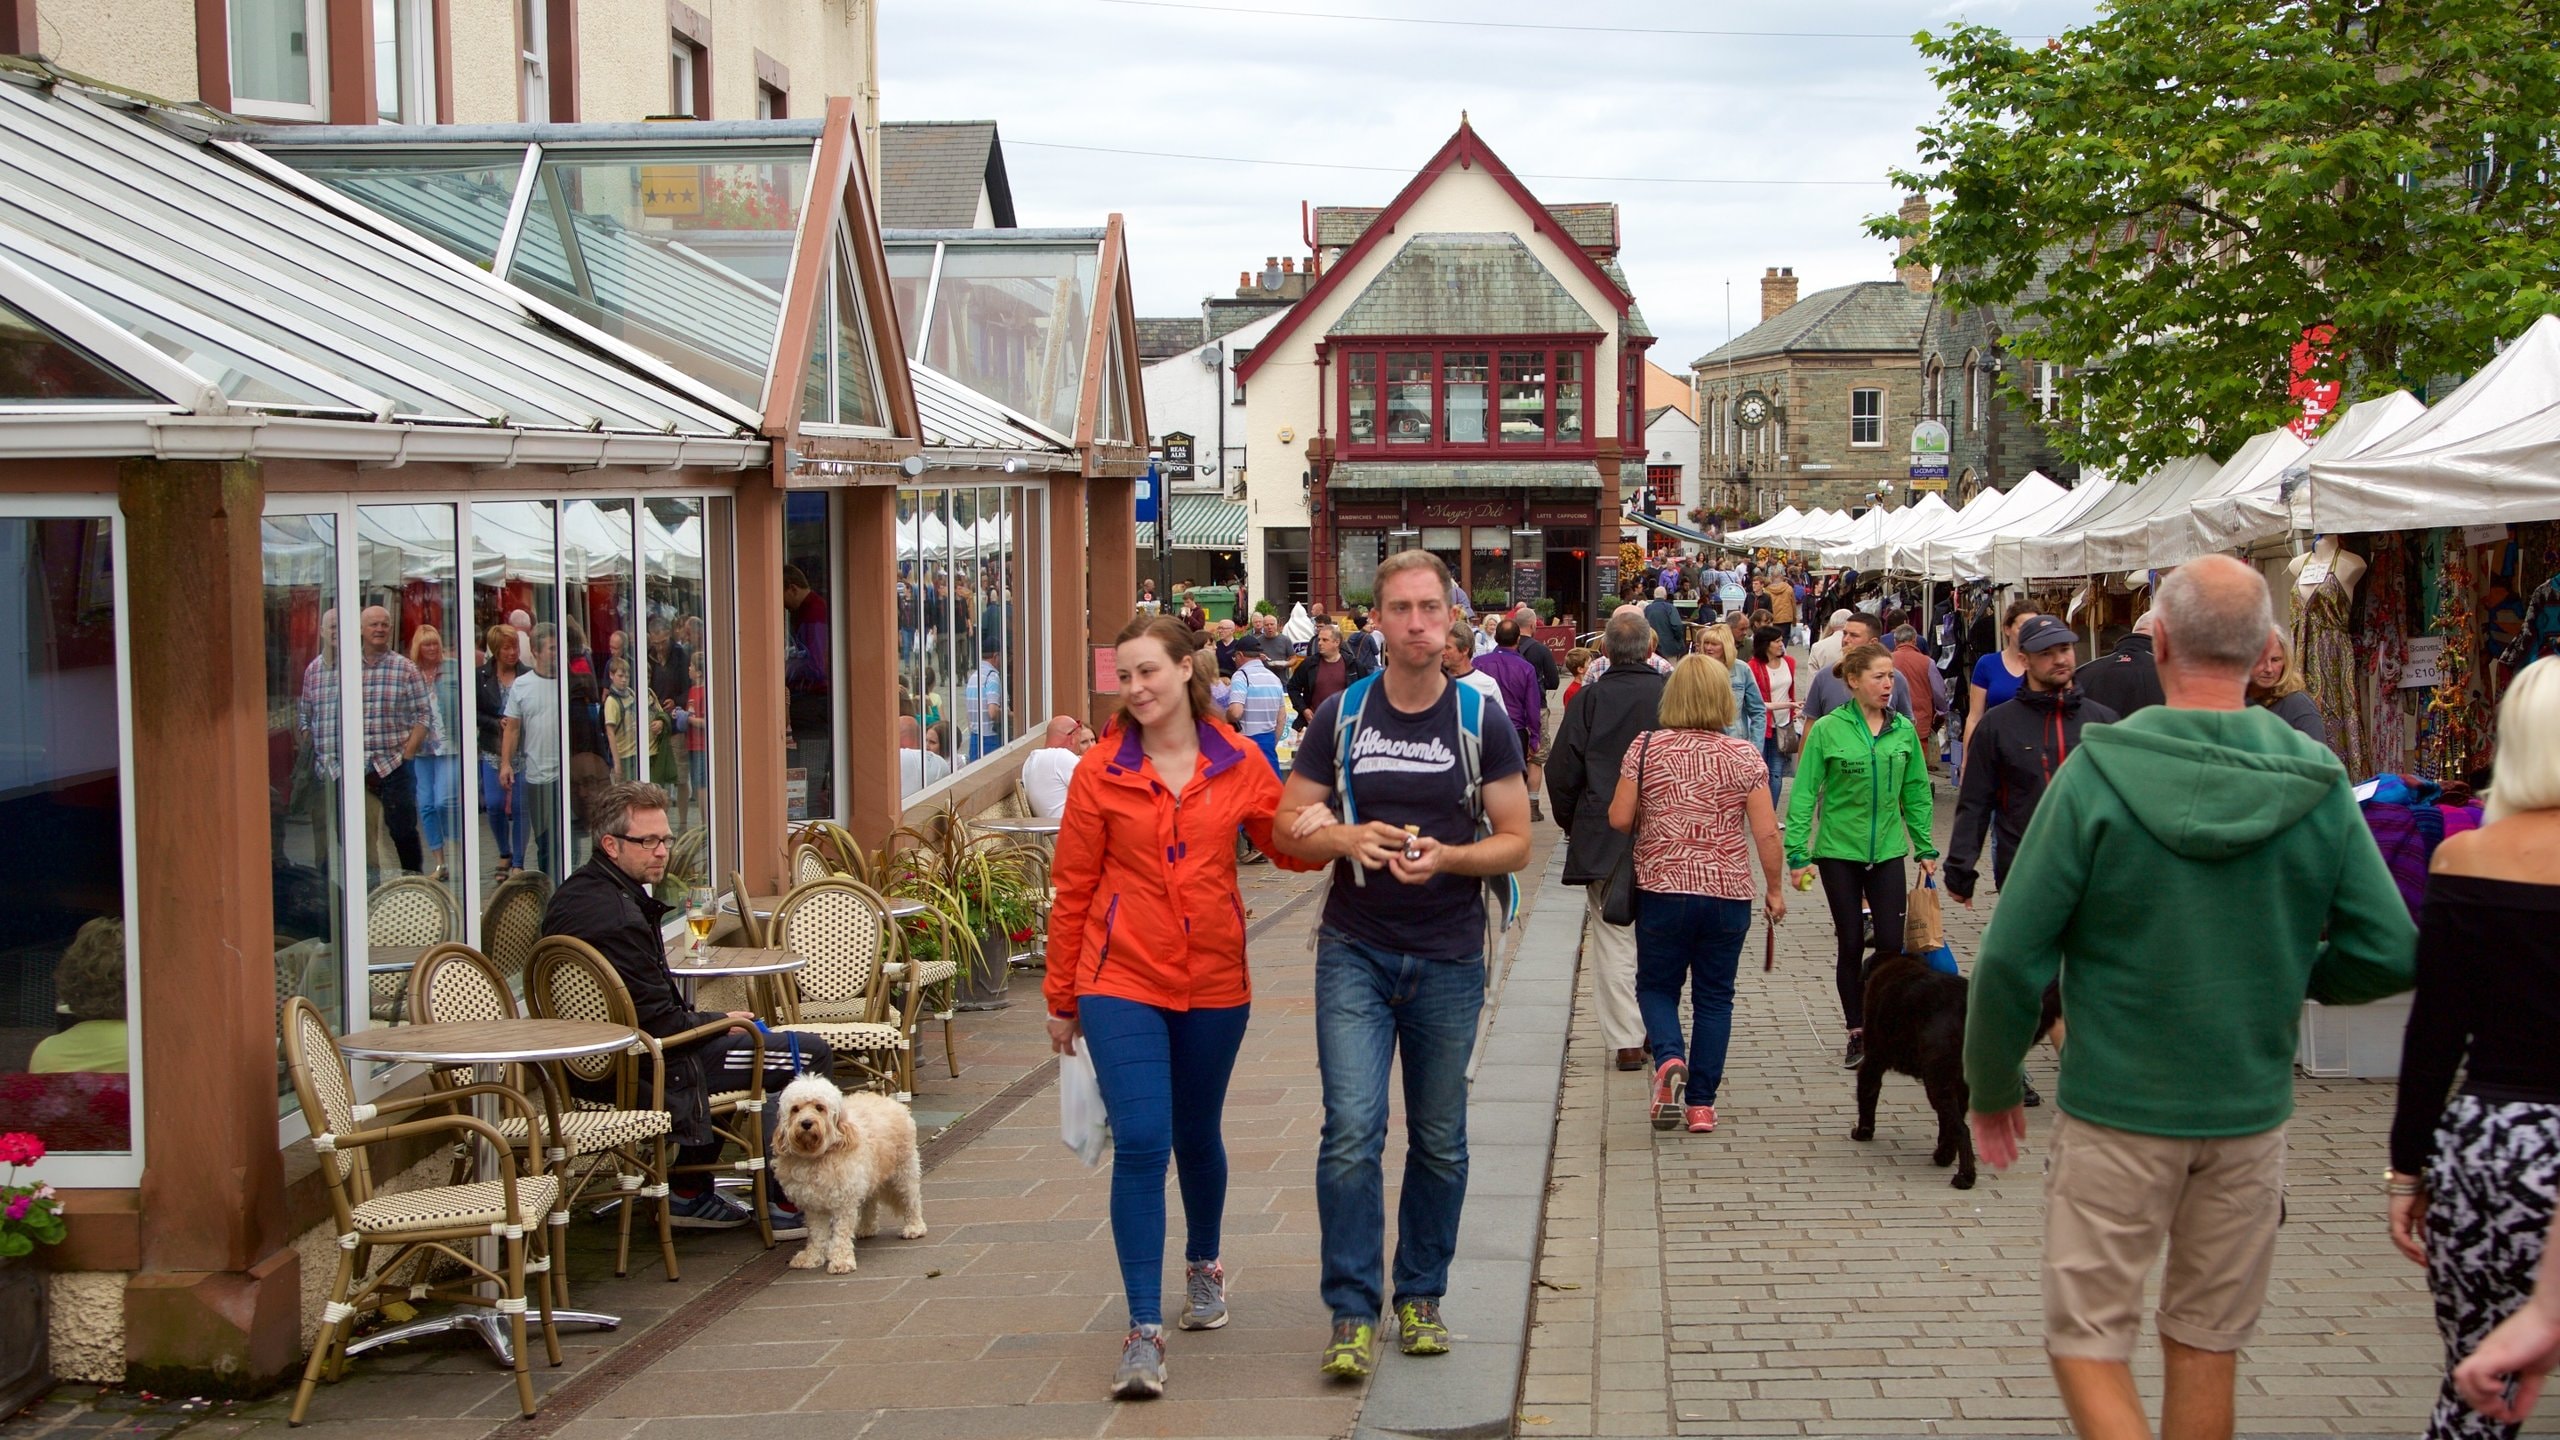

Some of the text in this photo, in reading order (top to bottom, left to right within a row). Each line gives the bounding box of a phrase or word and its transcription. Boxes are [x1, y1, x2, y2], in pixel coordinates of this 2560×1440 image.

[1474, 547, 1487, 556] cold
[2409, 643, 2440, 653] Scarves
[2414, 667, 2436, 678] £10
[1352, 726, 1455, 763] Abercrombie
[1360, 759, 1380, 769] NEW
